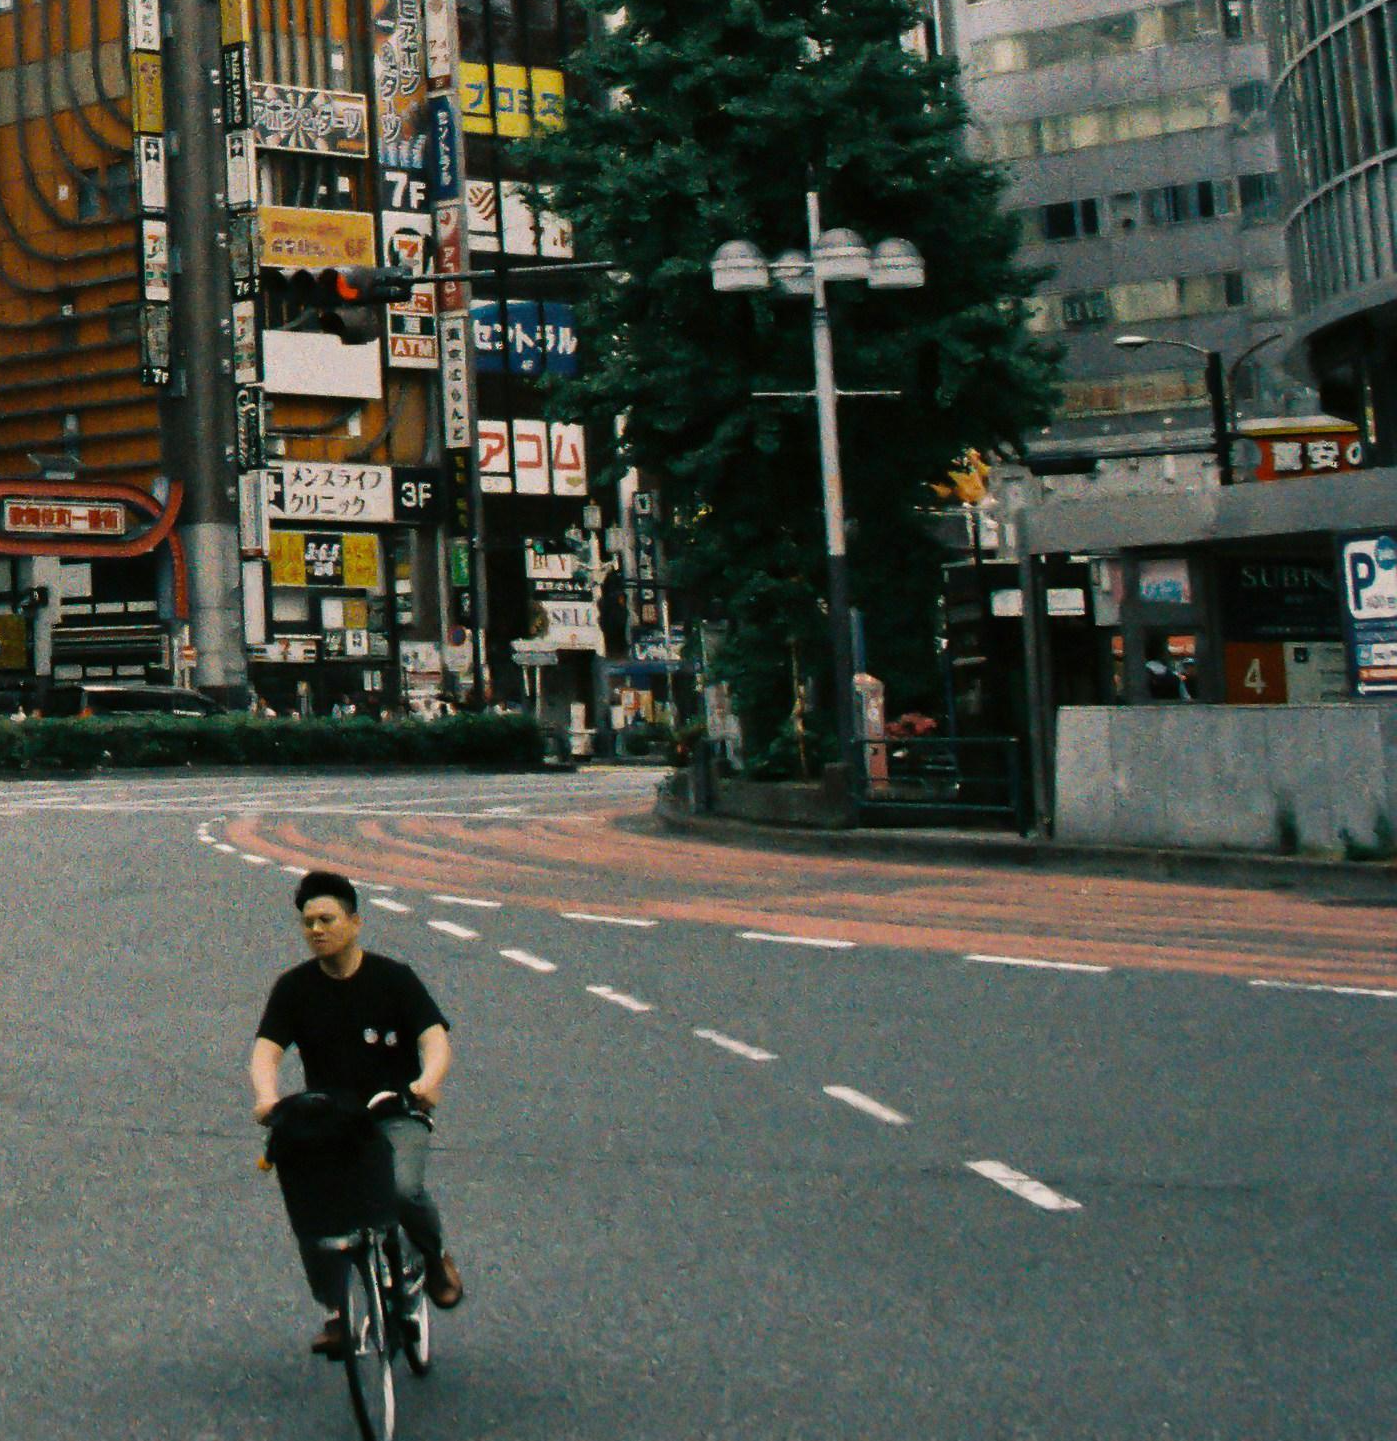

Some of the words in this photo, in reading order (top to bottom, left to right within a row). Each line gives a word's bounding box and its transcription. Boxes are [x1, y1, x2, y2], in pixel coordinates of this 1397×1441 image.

[464, 81, 564, 122] プロミス
[385, 171, 427, 210] 7F
[479, 431, 582, 471] アコム
[400, 481, 433, 509] 3F
[1244, 658, 1268, 695] 4
